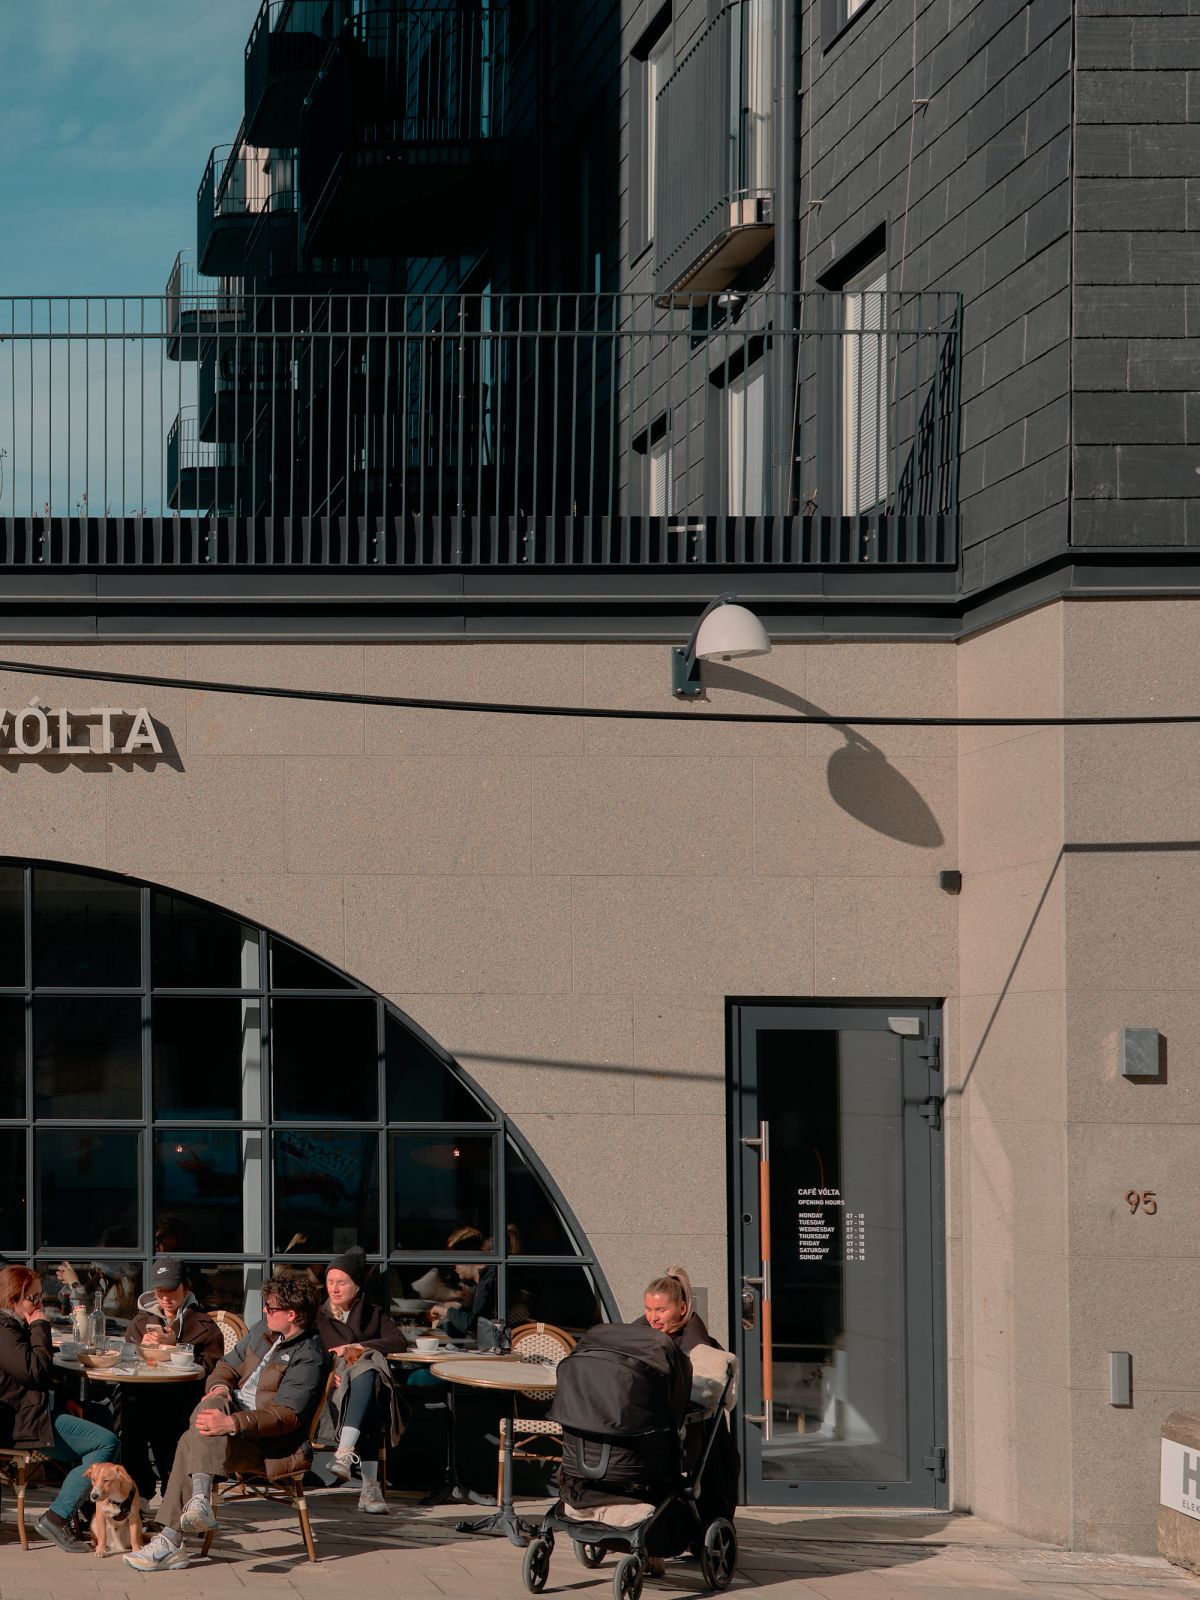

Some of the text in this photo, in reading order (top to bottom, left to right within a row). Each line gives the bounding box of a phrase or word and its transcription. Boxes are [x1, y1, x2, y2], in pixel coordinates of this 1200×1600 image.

[798, 1188, 840, 1196] CAFÉ VÓLTA
[1125, 1190, 1157, 1215] 95
